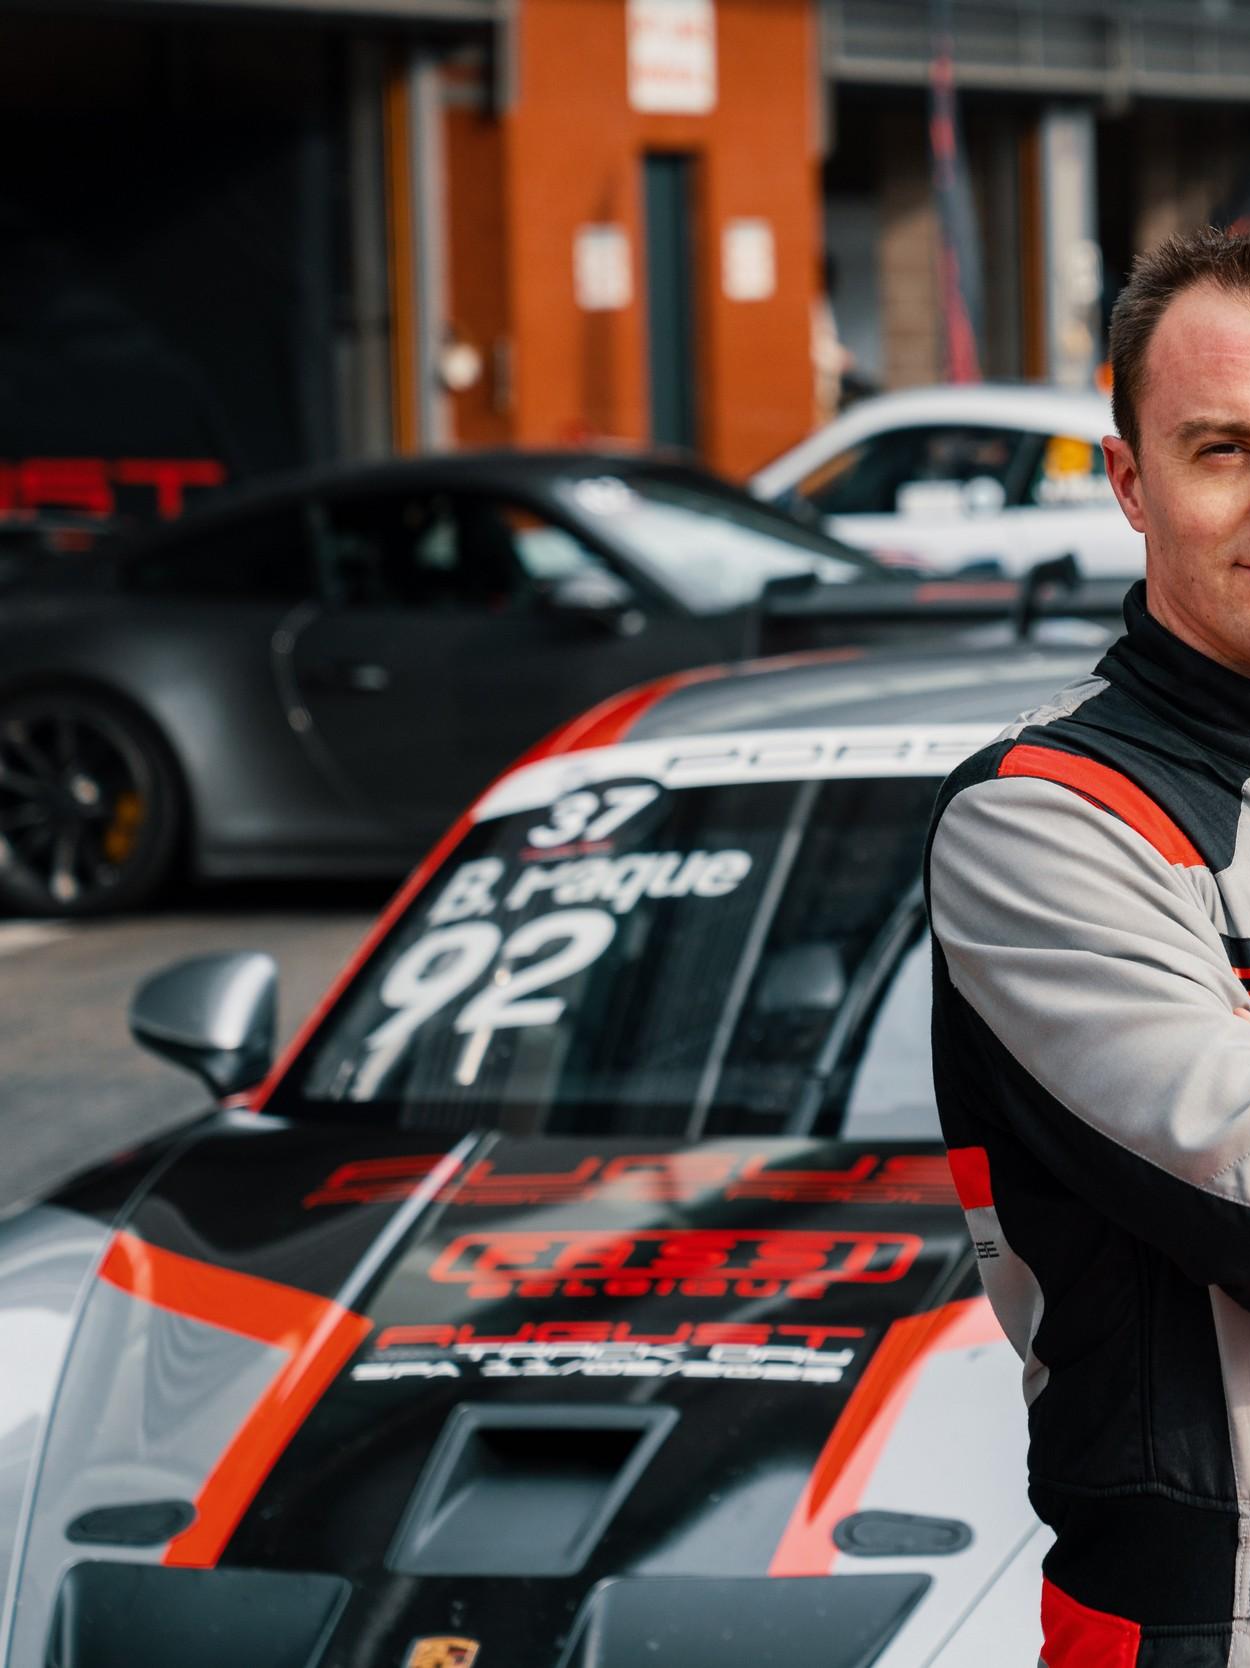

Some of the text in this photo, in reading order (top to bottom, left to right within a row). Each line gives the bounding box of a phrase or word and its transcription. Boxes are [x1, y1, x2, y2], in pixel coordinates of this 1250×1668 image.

[664, 740, 984, 773] PORS
[527, 784, 660, 848] 37
[428, 857, 505, 926] B.
[364, 908, 617, 1048] 92
